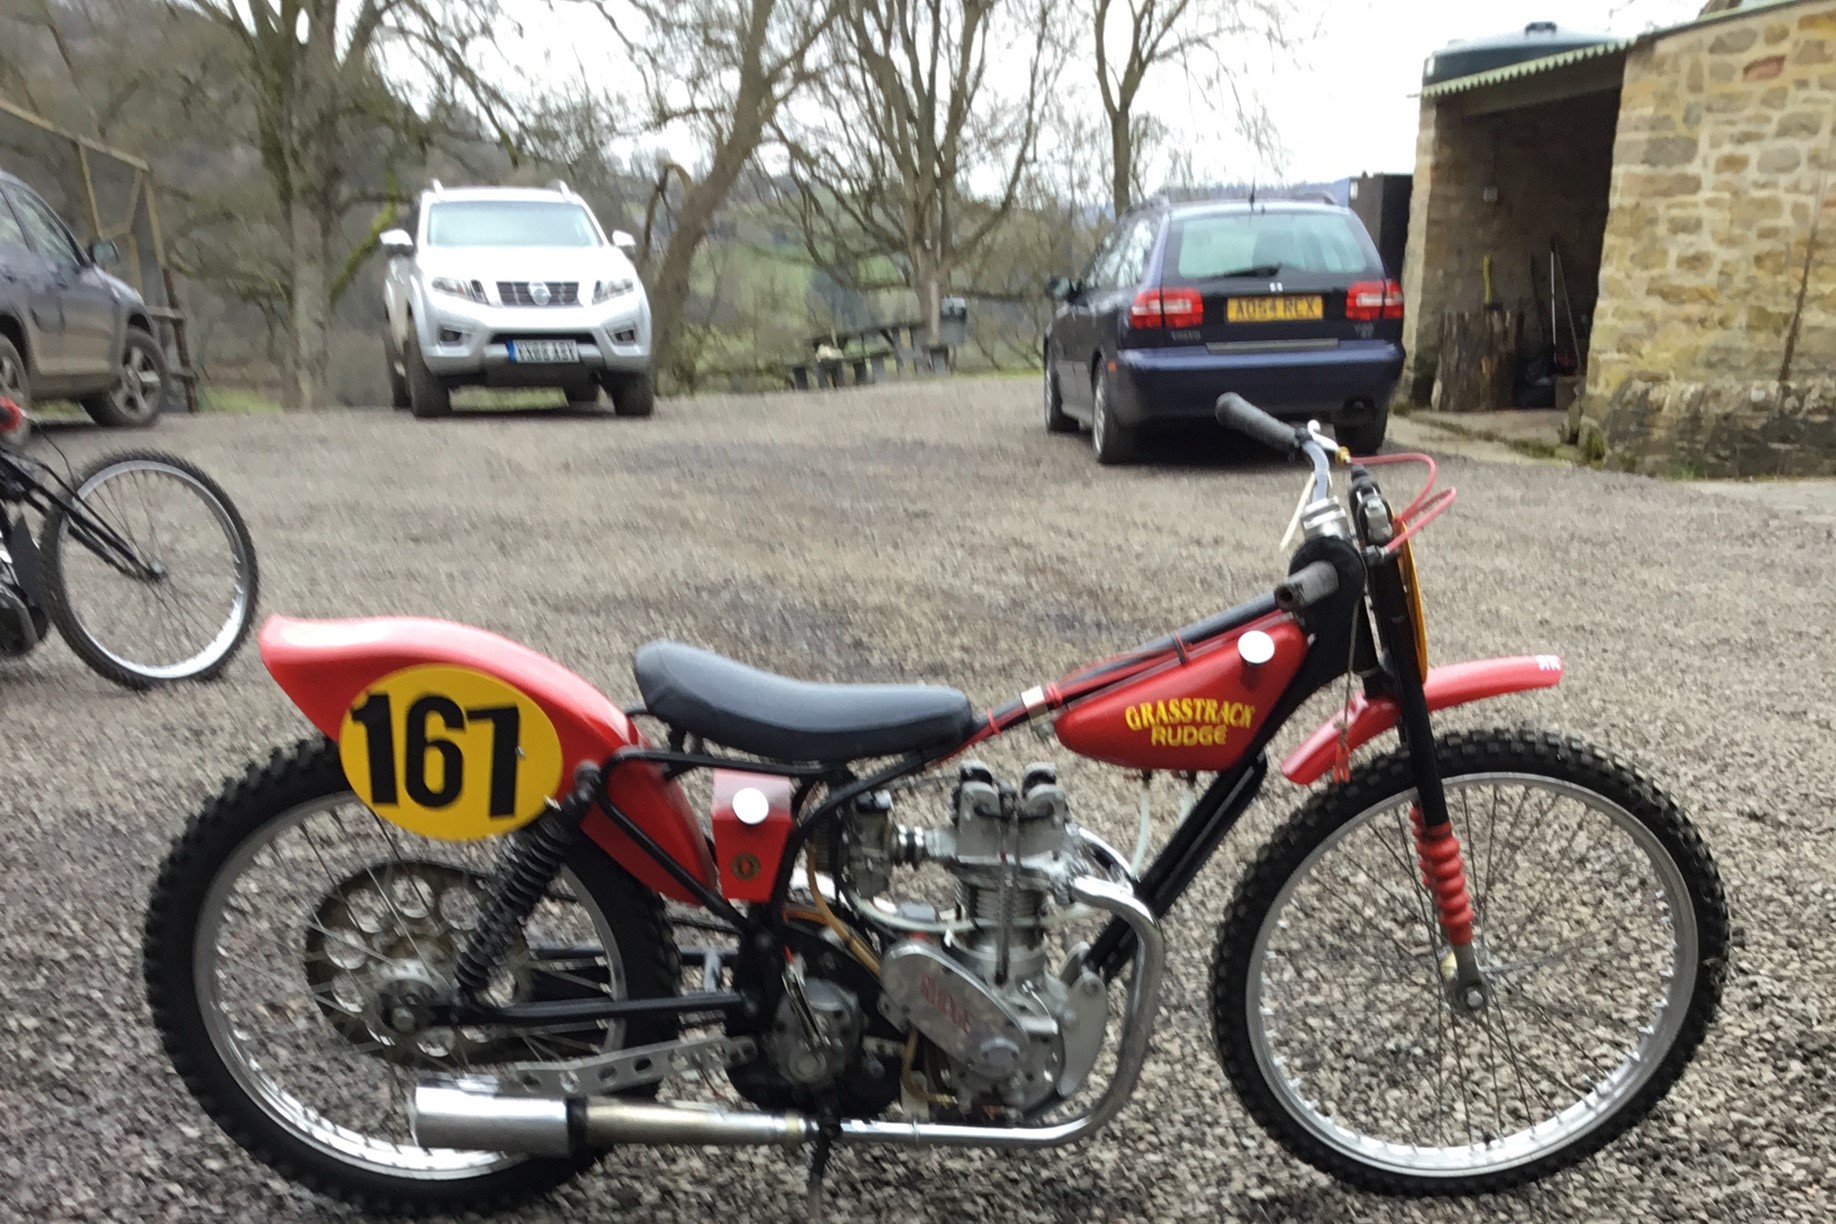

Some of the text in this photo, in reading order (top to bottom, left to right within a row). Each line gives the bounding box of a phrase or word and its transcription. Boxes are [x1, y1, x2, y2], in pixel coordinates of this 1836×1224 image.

[1125, 697, 1255, 731] GRASSTRACK
[1151, 724, 1228, 747] RUDGE
[351, 690, 520, 820] 167
